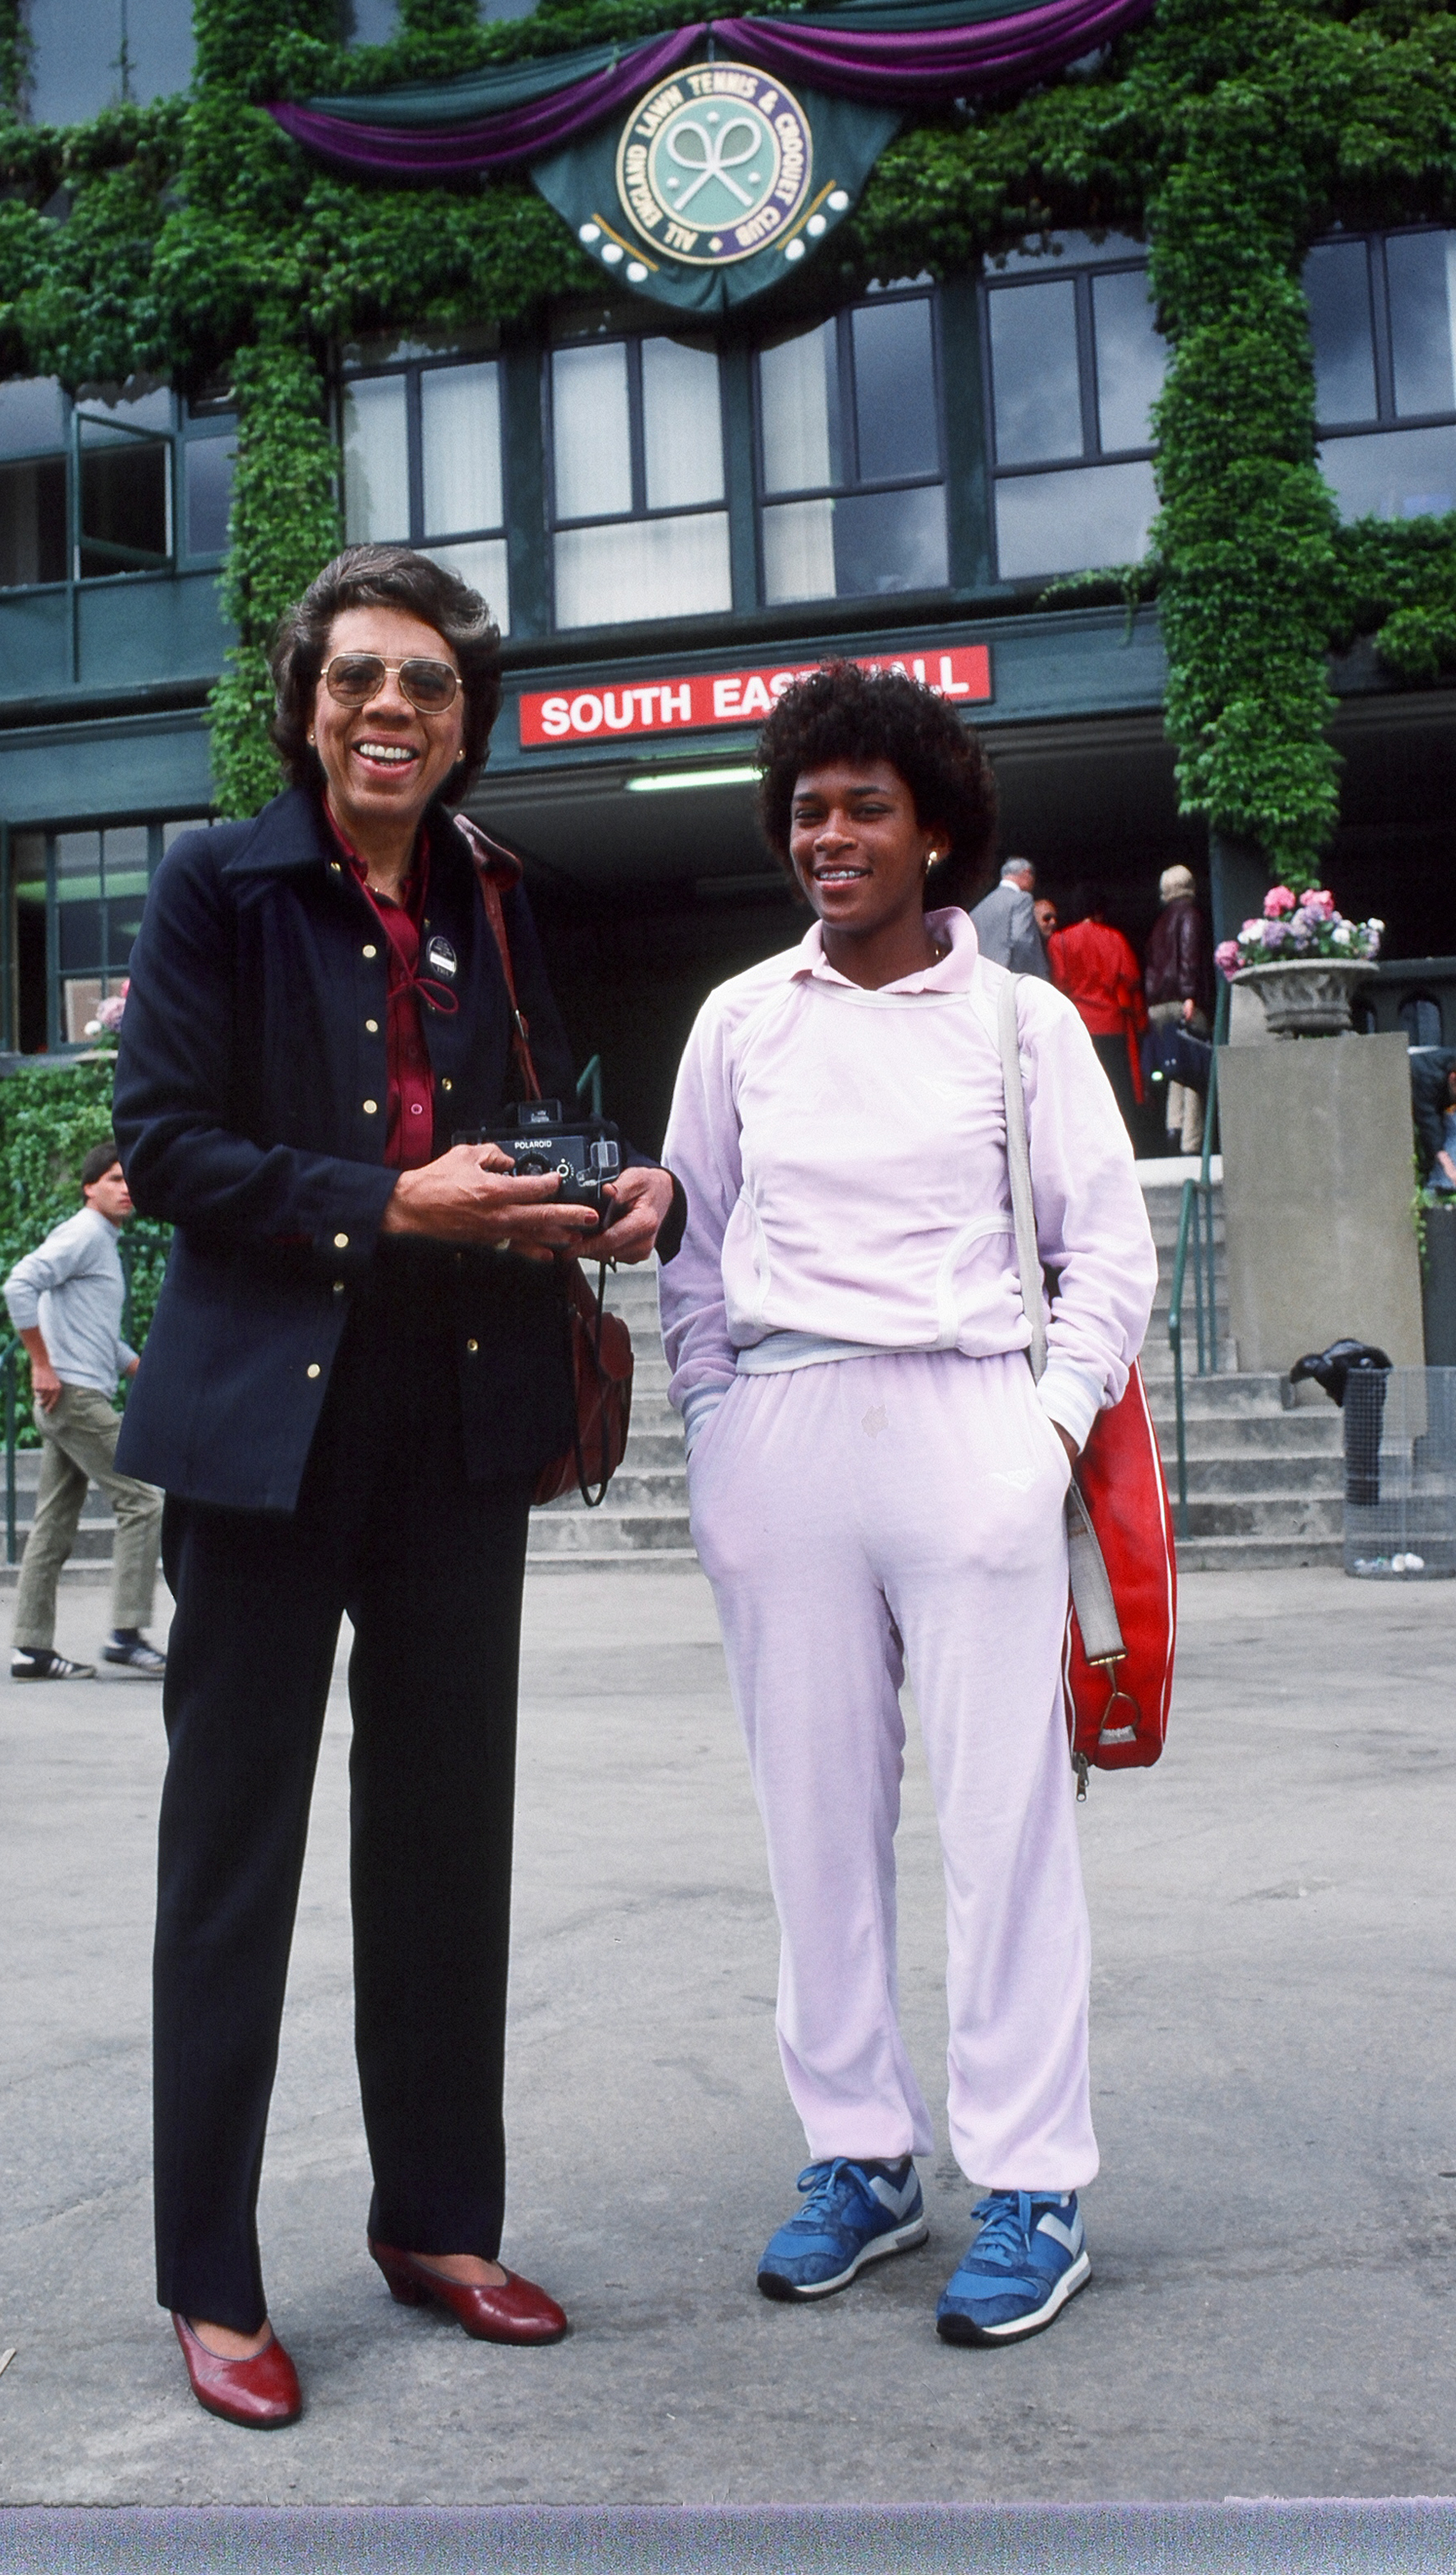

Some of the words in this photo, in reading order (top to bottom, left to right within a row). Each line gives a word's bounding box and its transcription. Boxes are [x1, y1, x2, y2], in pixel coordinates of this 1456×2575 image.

[687, 71, 758, 99] TENNIS
[758, 90, 779, 114] &
[635, 85, 684, 137] LAWN
[774, 113, 804, 206] CROQUET
[626, 144, 663, 228] ENGLAND
[663, 223, 699, 251] ALL
[735, 206, 781, 247] CLUB
[542, 683, 691, 736] SOUTH
[713, 669, 824, 717] EAS
[515, 1141, 553, 1150] POLAROID
